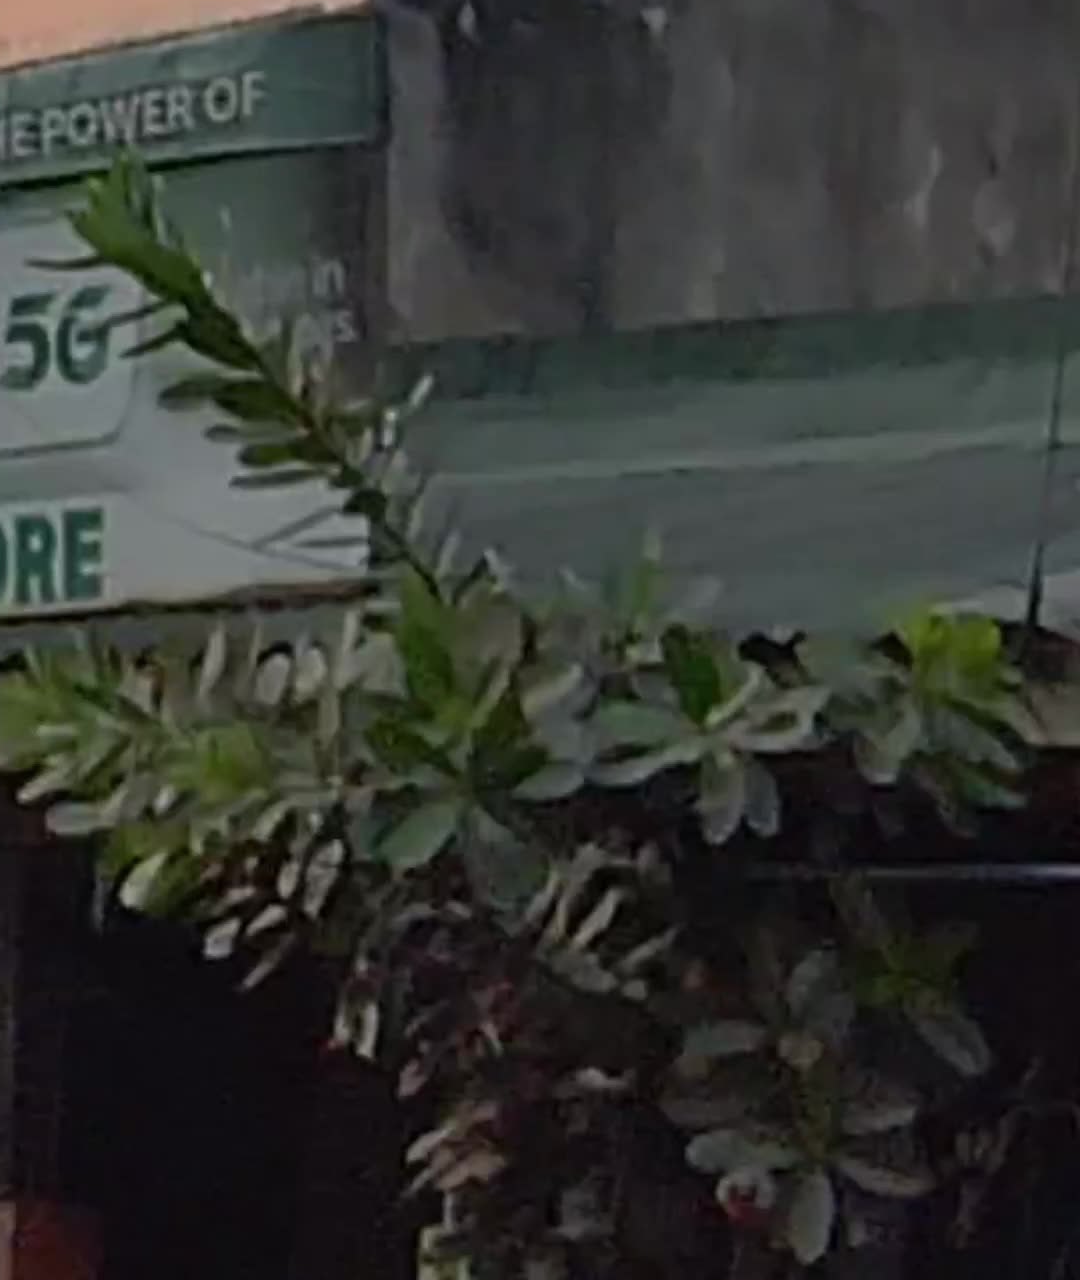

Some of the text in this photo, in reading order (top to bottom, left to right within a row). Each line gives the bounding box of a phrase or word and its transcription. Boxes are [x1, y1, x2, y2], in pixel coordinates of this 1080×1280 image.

[41, 85, 195, 155] POWER
[203, 70, 266, 123] OF
[0, 284, 114, 391] 5G
